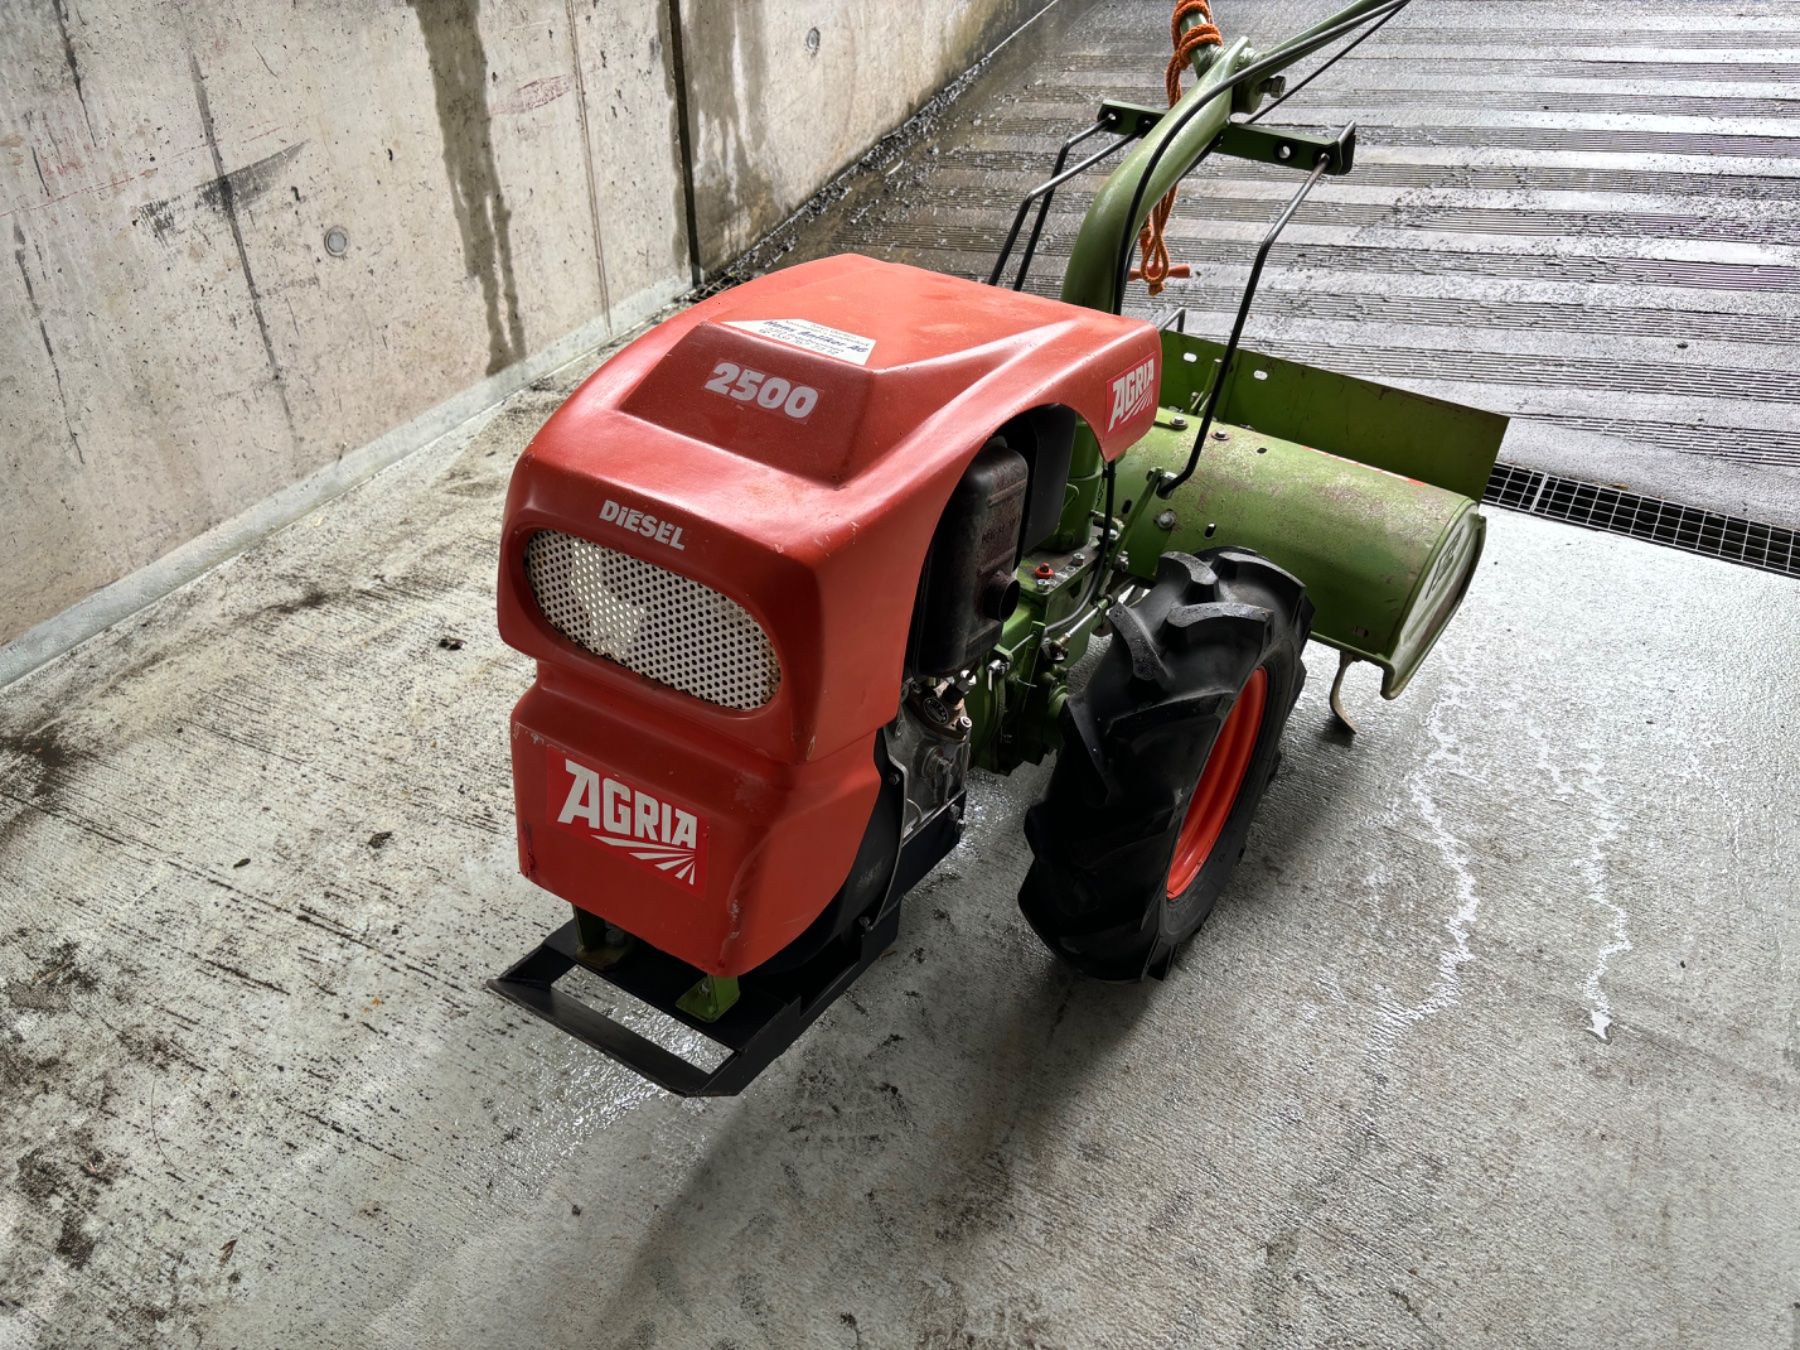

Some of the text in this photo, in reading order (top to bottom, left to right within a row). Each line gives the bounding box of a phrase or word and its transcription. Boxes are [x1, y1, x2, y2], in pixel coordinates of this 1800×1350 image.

[704, 362, 819, 418] 2500
[1108, 358, 1154, 432] AGRIA
[599, 500, 685, 551] DIESEL
[557, 758, 698, 850] AGRIA
